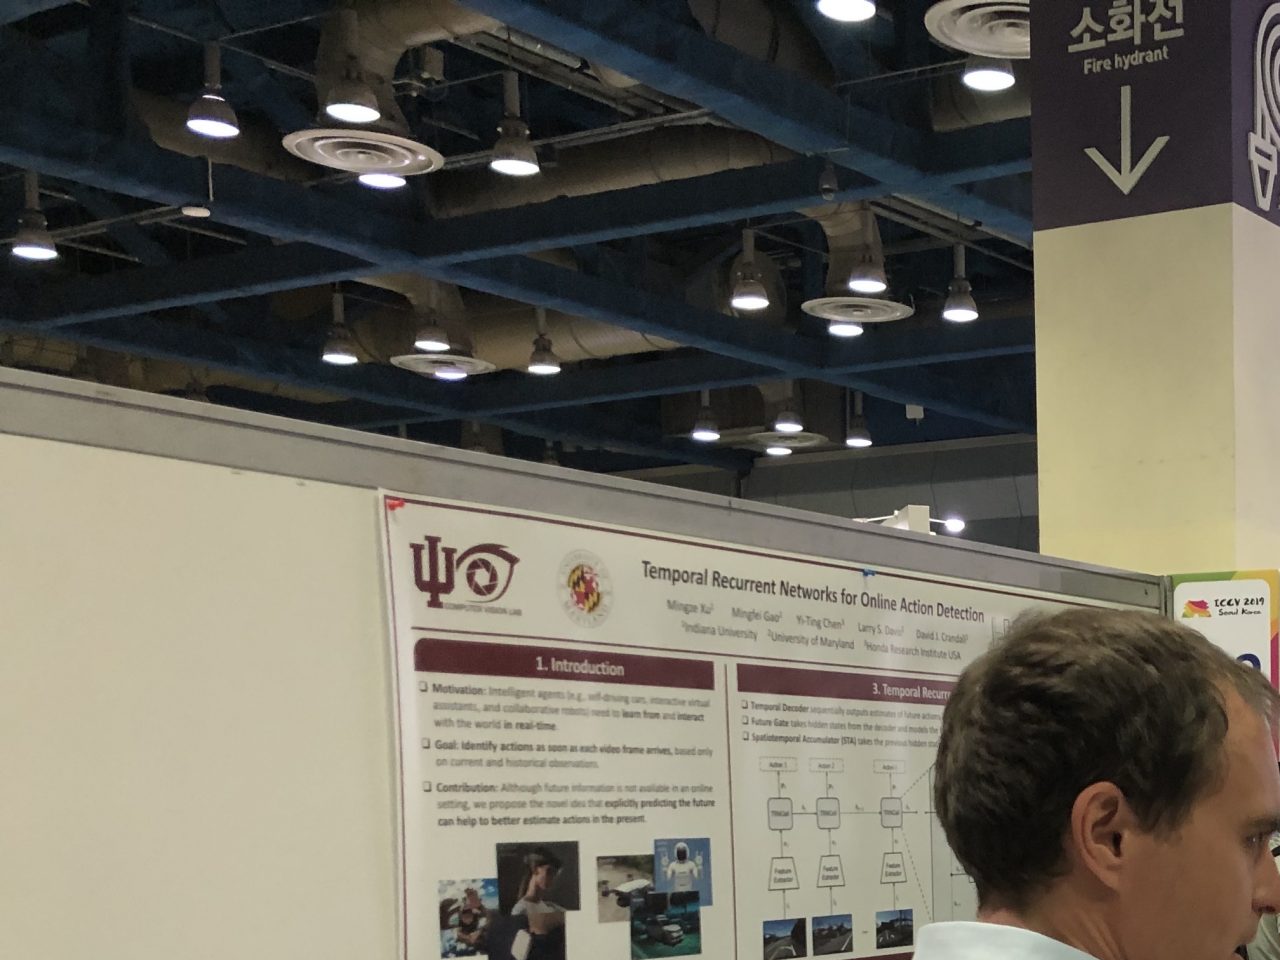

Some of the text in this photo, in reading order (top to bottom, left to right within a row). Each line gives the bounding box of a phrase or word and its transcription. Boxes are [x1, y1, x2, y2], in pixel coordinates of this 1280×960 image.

[1083, 45, 1169, 74] Fire hydrant
[642, 561, 985, 624] Temporal Recurrent Networks for Online Action Detection
[1214, 596, 1264, 607] ICCV 2019
[1218, 608, 1238, 616] Seoul
[796, 614, 822, 629] Yi-Ting
[717, 626, 758, 641] University
[858, 622, 876, 635] Larry
[916, 629, 934, 640] David
[810, 635, 855, 650] of Maryland
[890, 644, 962, 660] Research Institute USA
[536, 656, 625, 677] 1. Introduction
[432, 683, 487, 696] Motivation:
[872, 683, 920, 700] 3. Temporal
[751, 701, 781, 713] Temporal
[782, 703, 809, 713] Decoder
[503, 720, 513, 729] in
[751, 718, 772, 727] Future
[773, 719, 789, 727] Gate
[847, 722, 862, 730] from
[863, 722, 873, 731] the
[751, 732, 801, 744] Spatiotemporal
[802, 735, 840, 744] Accumulator
[840, 735, 856, 747] (STA)
[434, 739, 460, 750] Goal:
[461, 740, 498, 752] Identify
[500, 742, 533, 752] actions
[599, 745, 621, 755] video
[622, 745, 644, 754] frame
[450, 758, 484, 767] current
[436, 782, 498, 793] Contribution:
[640, 799, 677, 809] predicting
[678, 799, 691, 808] the
[692, 798, 715, 808] future
[438, 817, 454, 827] can
[456, 816, 477, 828] help
[479, 817, 489, 826] to
[491, 816, 521, 826] better
[523, 816, 560, 825] estimate
[562, 815, 590, 825] actions
[602, 815, 614, 824] the
